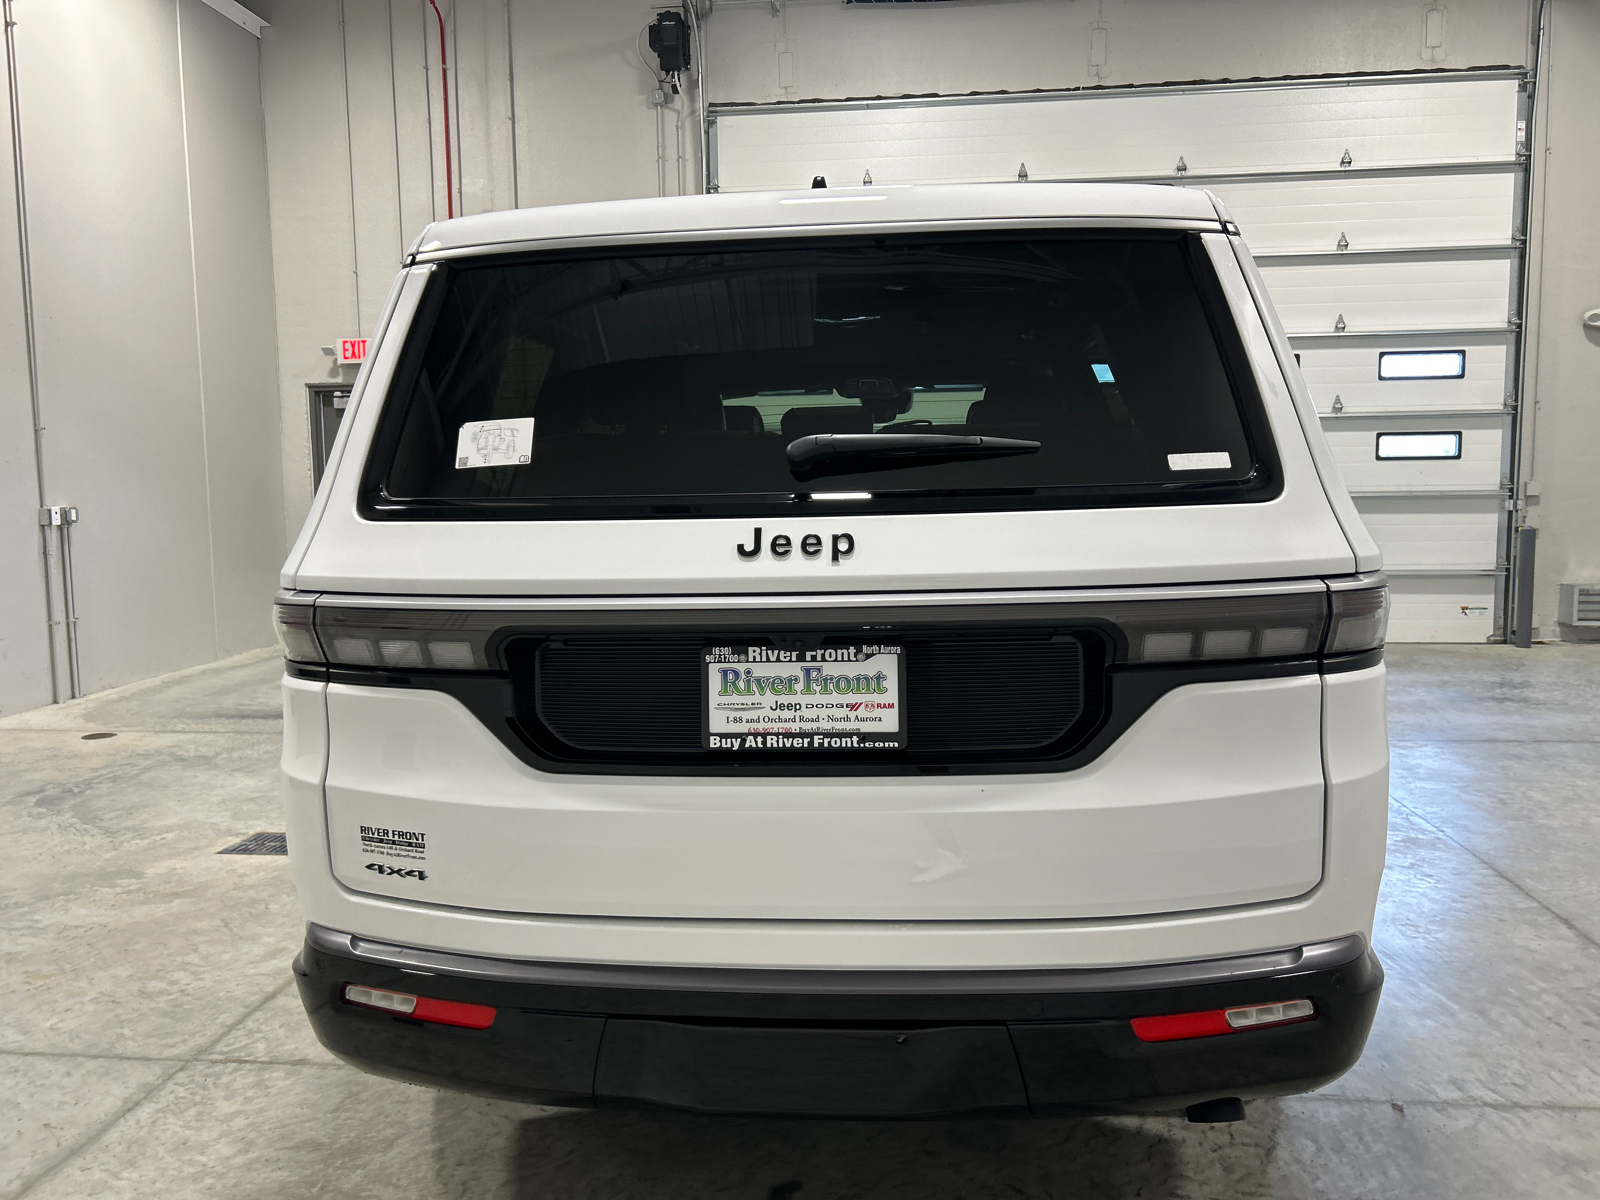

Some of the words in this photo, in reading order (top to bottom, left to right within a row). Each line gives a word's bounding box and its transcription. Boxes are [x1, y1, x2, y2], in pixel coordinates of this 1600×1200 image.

[342, 340, 367, 360] EXIT
[737, 527, 855, 564] Jeep
[712, 647, 732, 655] (630)
[748, 646, 800, 662] River
[862, 645, 880, 654] North
[880, 645, 901, 654] Aurora
[705, 654, 739, 663] 907-1700
[718, 667, 801, 696] River
[800, 666, 889, 695] Front
[770, 700, 802, 713] Jeep
[876, 702, 895, 710] RAM
[726, 715, 744, 724] I-88
[745, 715, 761, 724] and
[762, 715, 797, 724] Orchard
[799, 714, 820, 723] Road
[827, 714, 852, 723] North
[853, 714, 882, 723] Aurora
[709, 735, 741, 750] Buy
[744, 735, 763, 748] At
[766, 735, 811, 748] River
[360, 825, 390, 838] RIVER
[392, 829, 426, 842] FRONT
